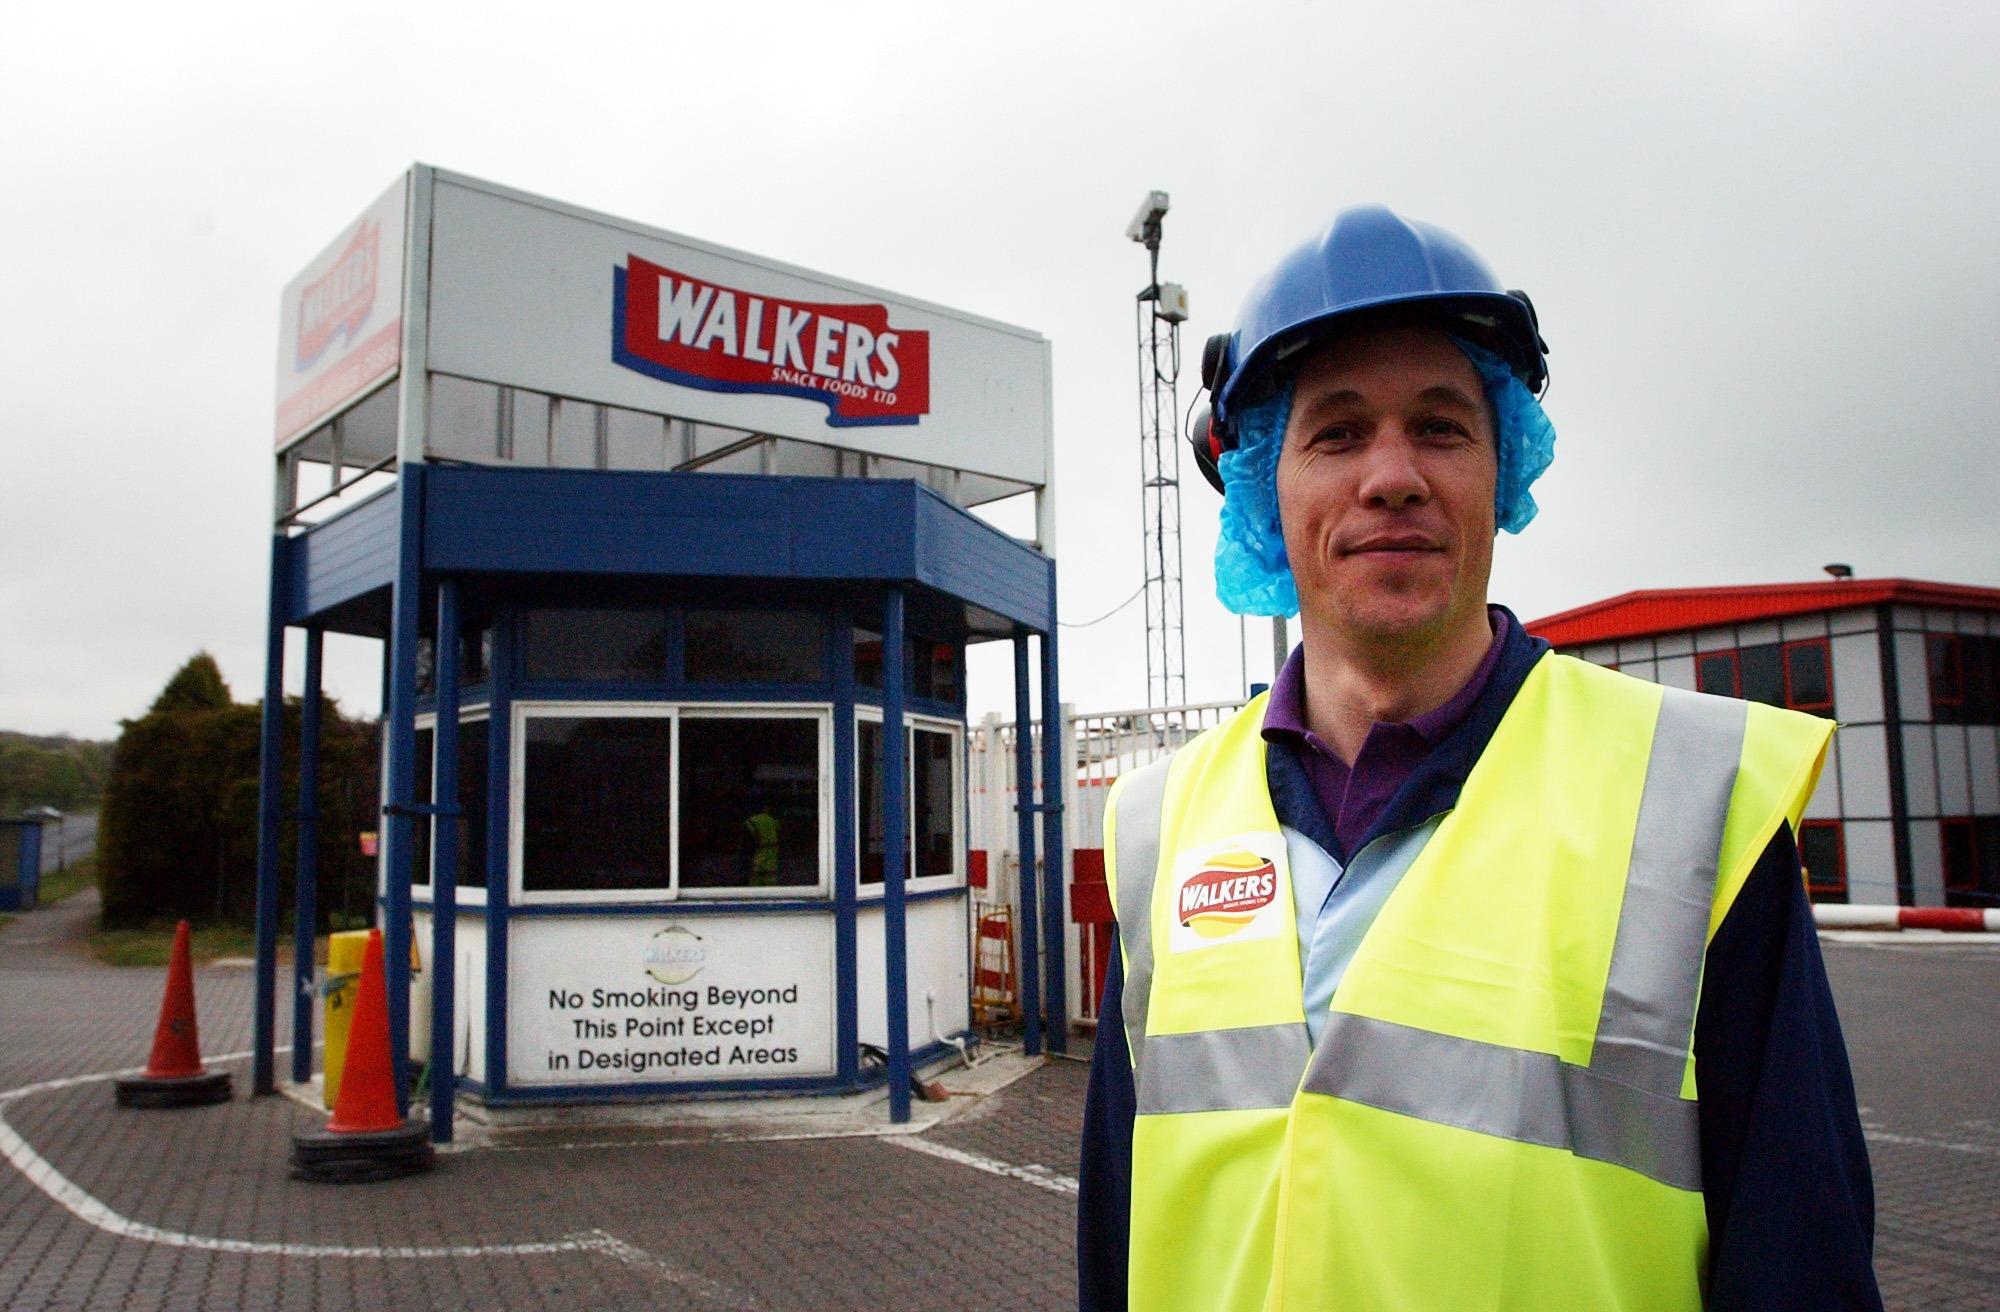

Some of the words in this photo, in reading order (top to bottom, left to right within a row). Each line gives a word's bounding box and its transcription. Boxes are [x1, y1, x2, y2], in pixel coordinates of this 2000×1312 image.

[658, 275, 901, 391] WALKERS
[771, 367, 818, 388] SNACK
[822, 378, 869, 400] FOODS
[873, 389, 898, 406] LTD
[1181, 873, 1274, 912] WALKERS
[550, 989, 584, 1009] No
[592, 987, 698, 1011] Smoking
[708, 985, 798, 1009] Beyond
[573, 1018, 617, 1039] This
[626, 1017, 684, 1038] Point
[694, 1014, 774, 1038] Except
[549, 1051, 569, 1070] in
[578, 1047, 720, 1073] Designated
[729, 1046, 798, 1065] Areas
